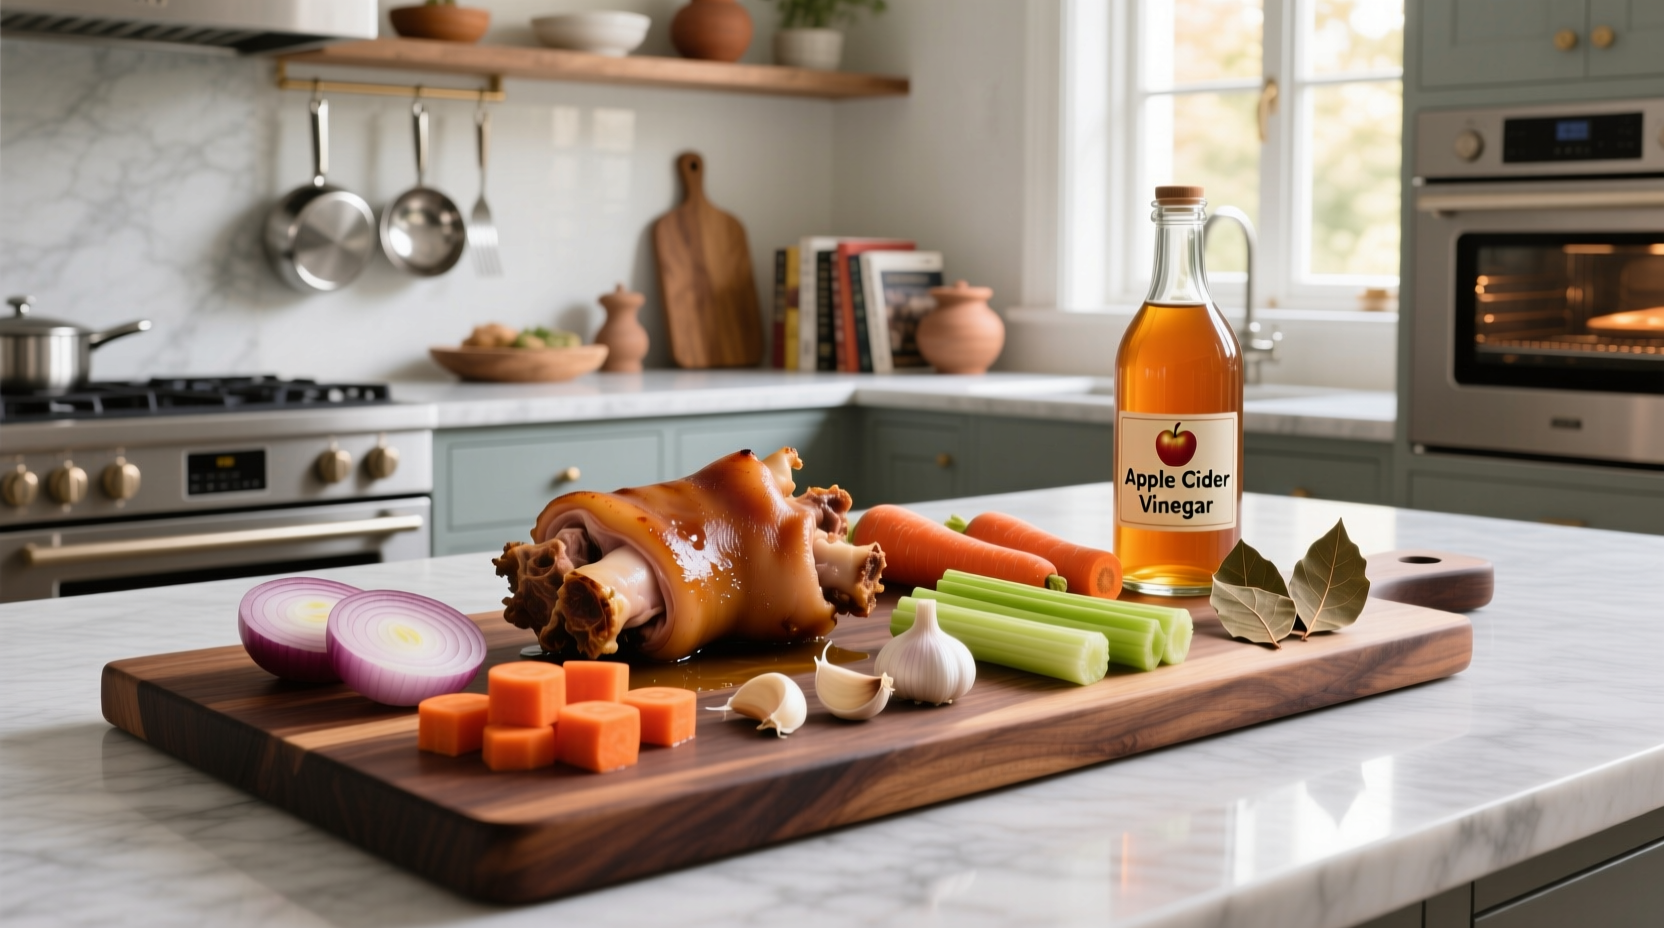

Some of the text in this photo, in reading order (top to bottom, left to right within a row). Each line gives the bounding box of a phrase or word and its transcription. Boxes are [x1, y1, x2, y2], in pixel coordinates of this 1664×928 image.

[1125, 468, 1230, 492] Apple Cider
[1139, 494, 1213, 520] Vinegar
